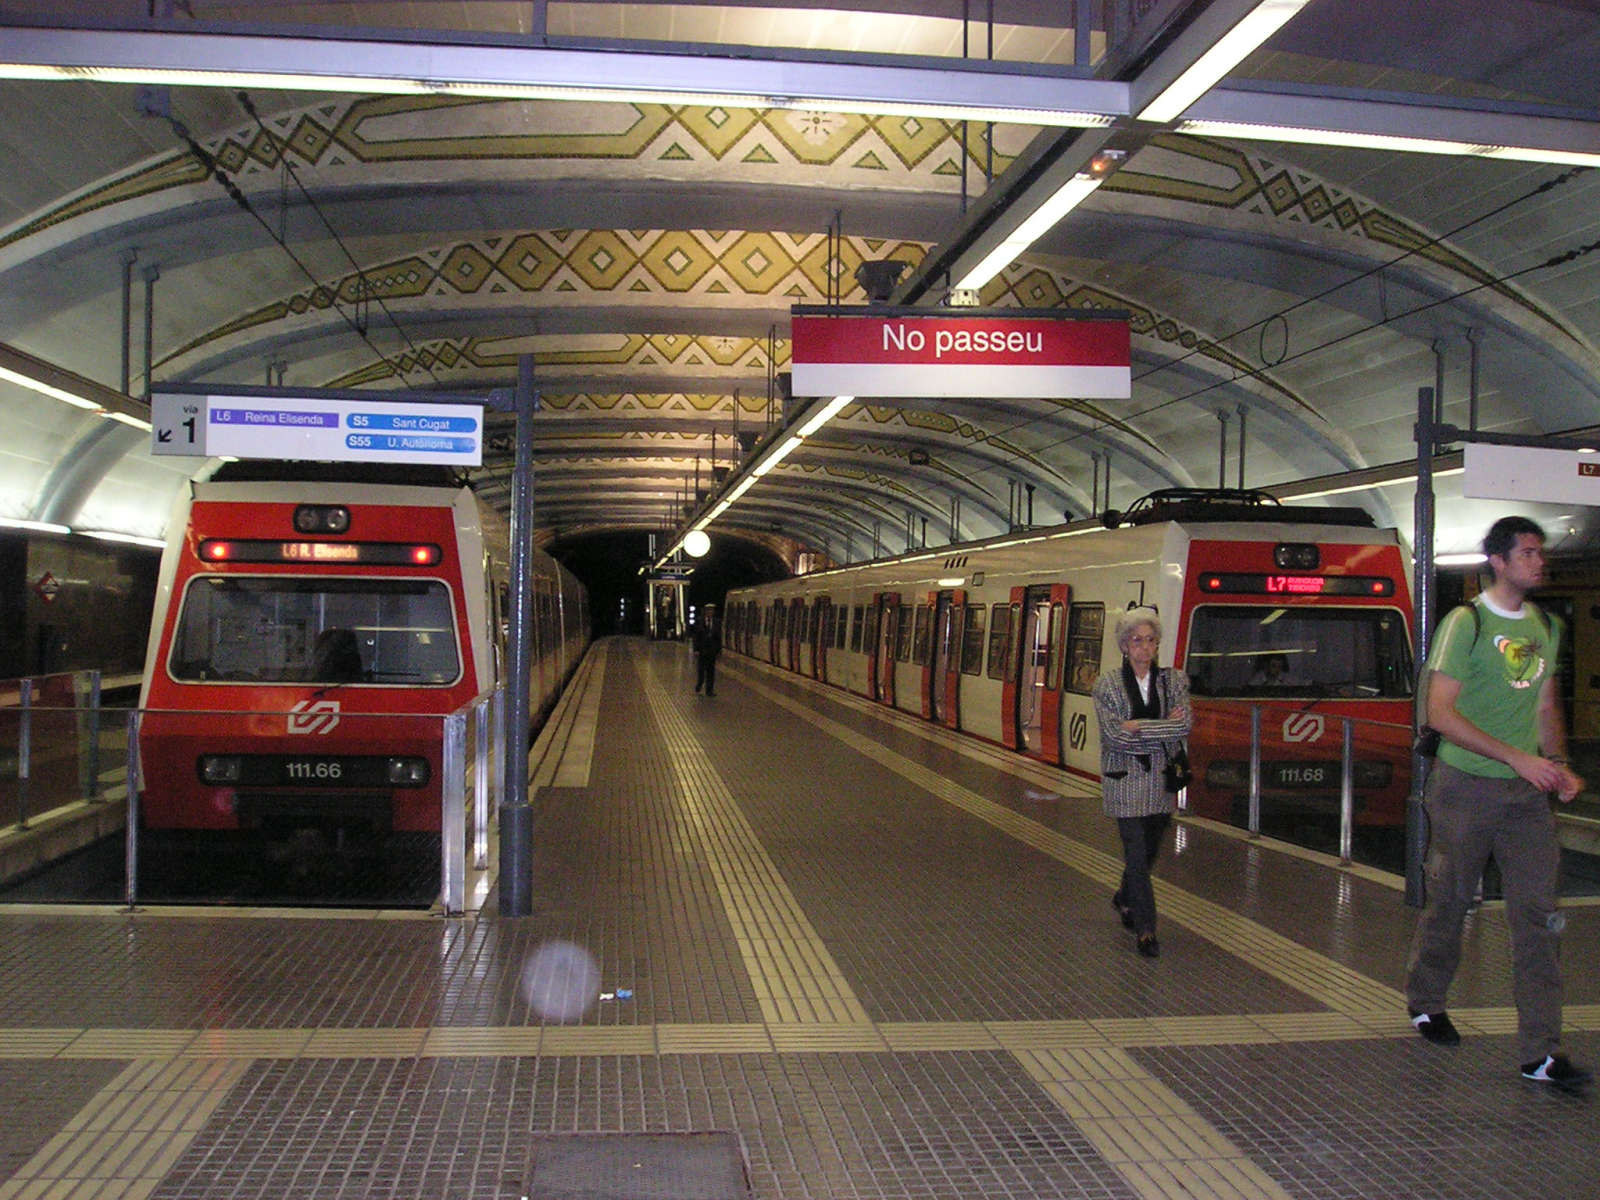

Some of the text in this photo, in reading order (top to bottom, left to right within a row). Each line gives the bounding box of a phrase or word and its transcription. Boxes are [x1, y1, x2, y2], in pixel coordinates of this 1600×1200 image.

[883, 323, 1043, 358] No passeu
[216, 410, 324, 425] L6 Reina Elisenda
[353, 415, 450, 431] S5 Sant Cugat
[182, 417, 195, 443] 1
[349, 435, 371, 447] S55
[1582, 463, 1594, 475] L7
[1268, 576, 1286, 592] L7
[286, 763, 341, 778] 111.66
[1280, 768, 1324, 782] 111.68
